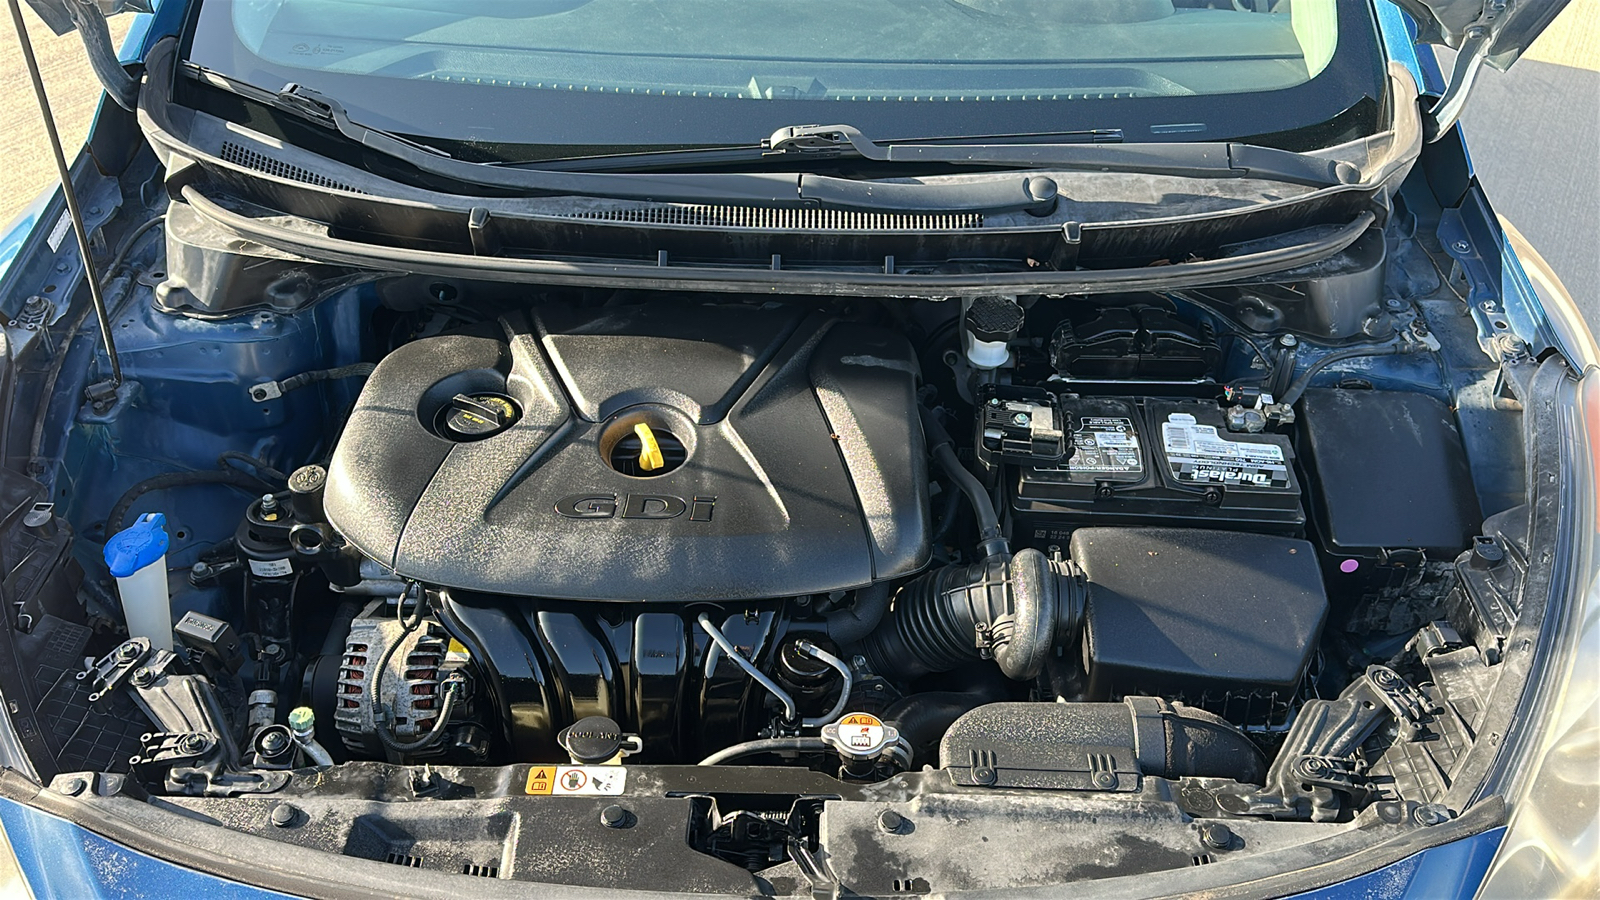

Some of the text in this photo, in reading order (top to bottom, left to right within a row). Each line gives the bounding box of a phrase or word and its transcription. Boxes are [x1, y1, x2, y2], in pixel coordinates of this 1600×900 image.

[1192, 464, 1239, 472] PLATINUM
[1193, 459, 1245, 467] TECHNOLOGY
[1191, 468, 1271, 485] Duralast
[554, 493, 718, 522] GDi
